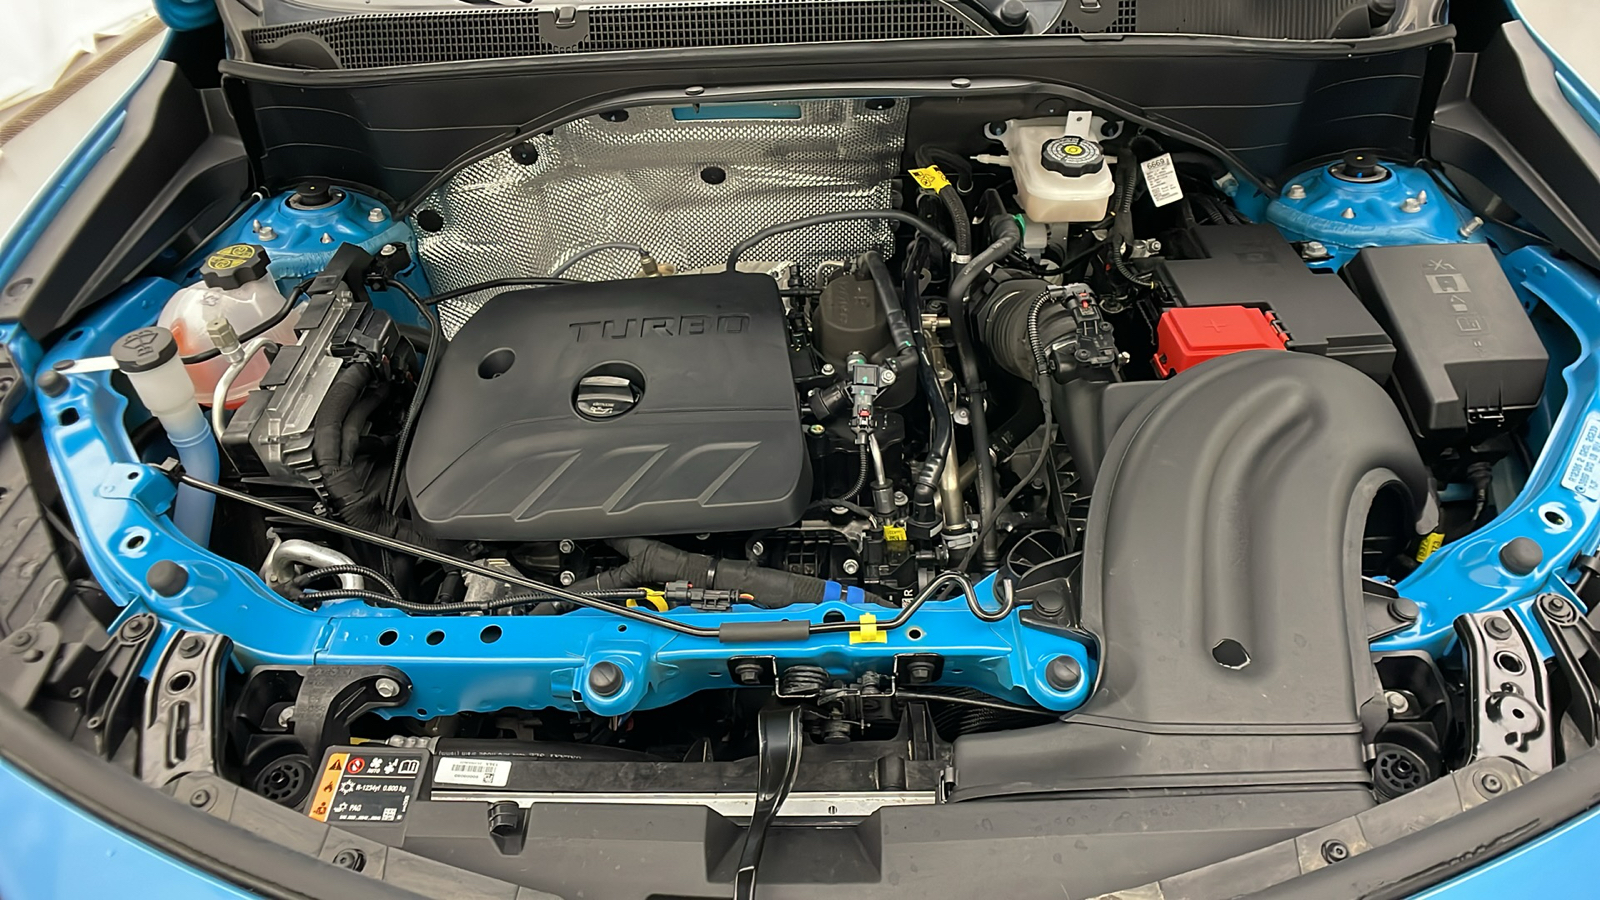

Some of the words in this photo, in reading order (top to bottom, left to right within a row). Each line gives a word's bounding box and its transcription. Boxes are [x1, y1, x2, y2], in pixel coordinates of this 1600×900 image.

[1147, 158, 1165, 170] 6669
[568, 313, 750, 343] TURBO
[398, 785, 407, 793] kg
[348, 804, 362, 812] PAG
